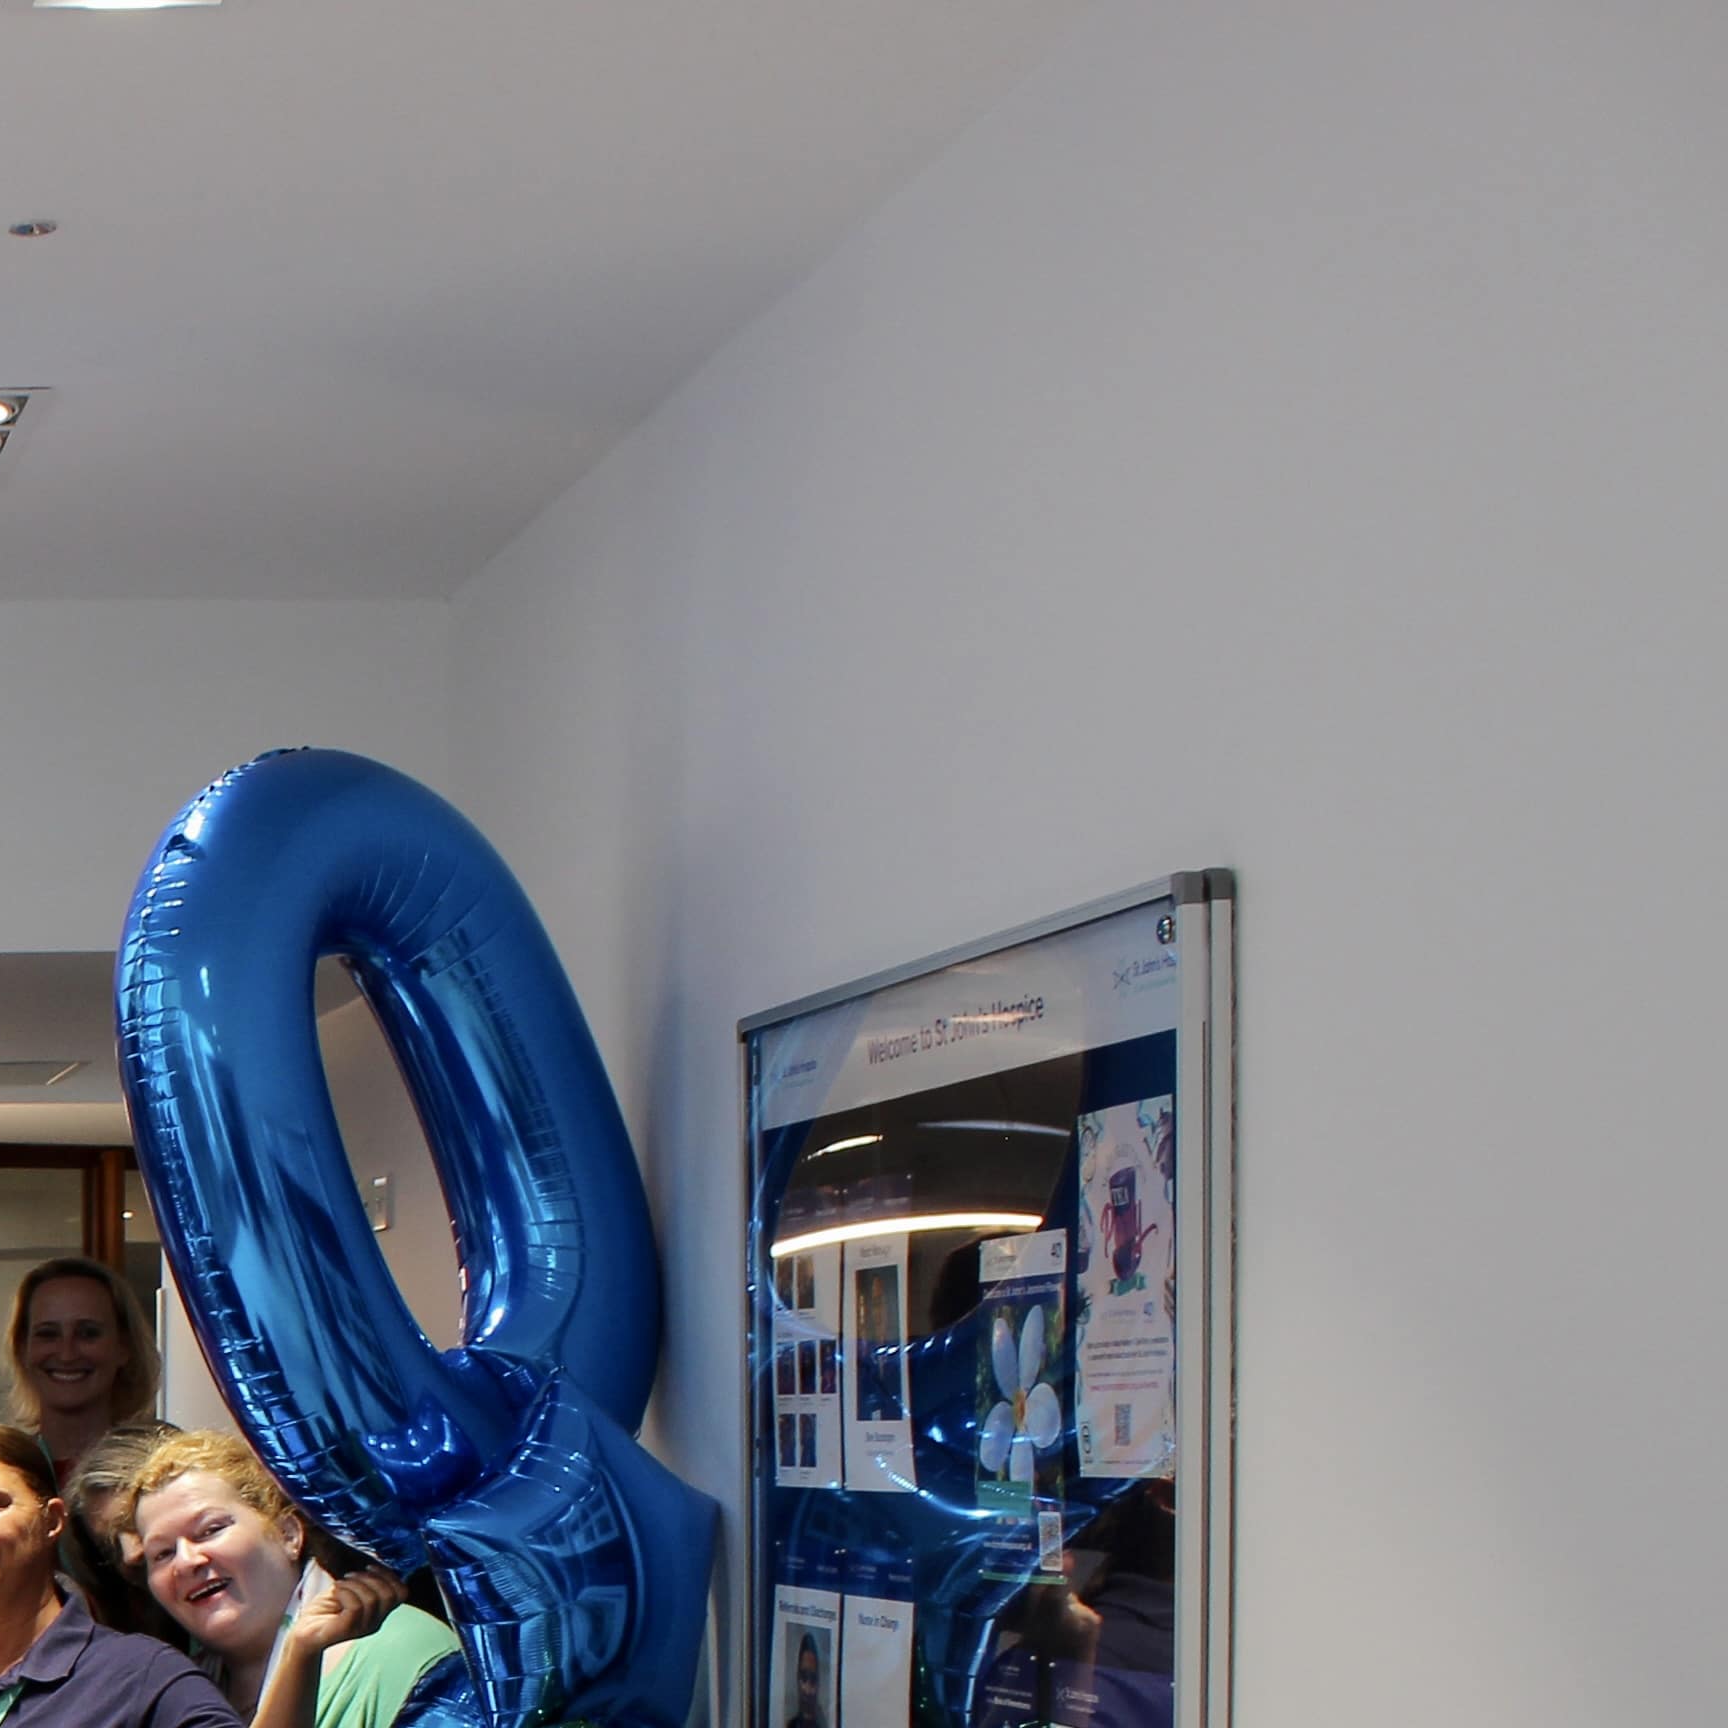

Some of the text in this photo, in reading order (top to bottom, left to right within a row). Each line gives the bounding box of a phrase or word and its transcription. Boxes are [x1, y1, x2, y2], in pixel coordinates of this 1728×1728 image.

[867, 1034, 919, 1065] Welcome
[920, 1027, 933, 1050] to
[935, 1017, 949, 1046] St
[992, 994, 1044, 1033] Hospice
